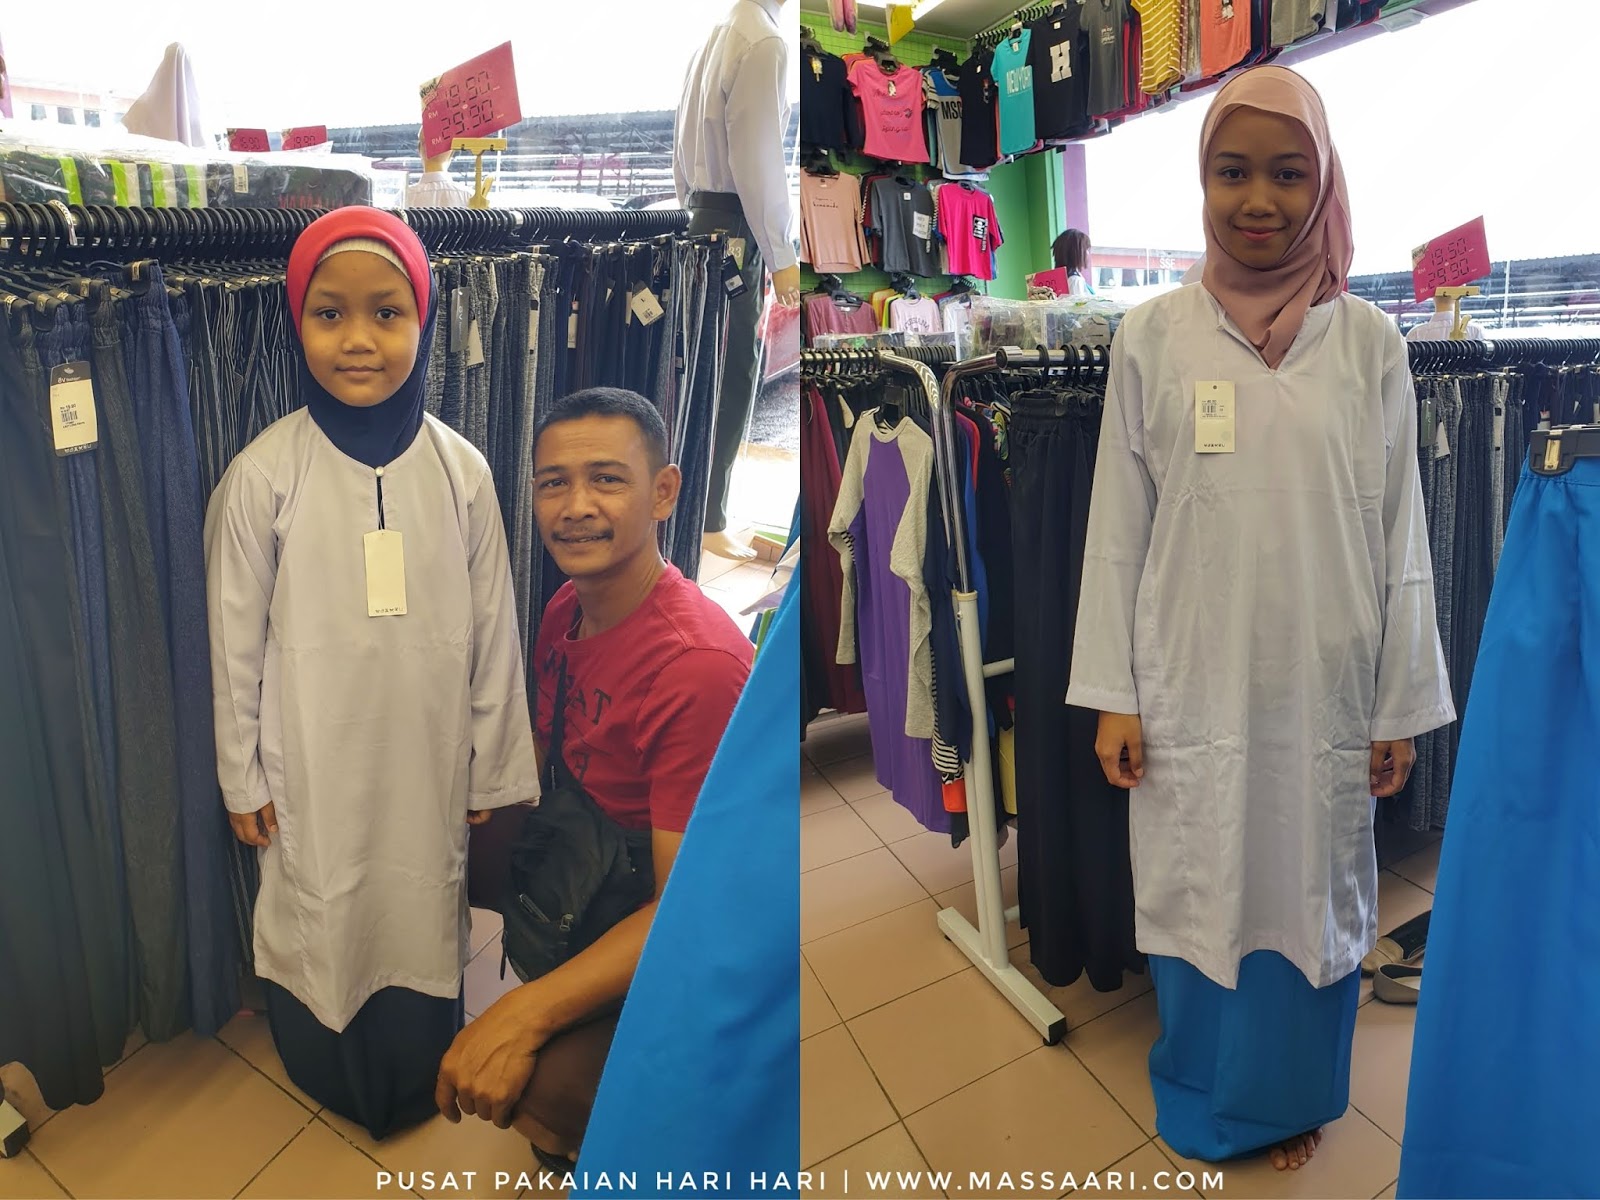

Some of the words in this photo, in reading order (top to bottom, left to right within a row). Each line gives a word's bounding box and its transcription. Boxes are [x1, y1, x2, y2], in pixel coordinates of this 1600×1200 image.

[1049, 39, 1073, 83] H
[441, 99, 494, 141] 29.90
[1427, 257, 1470, 290] 29.90
